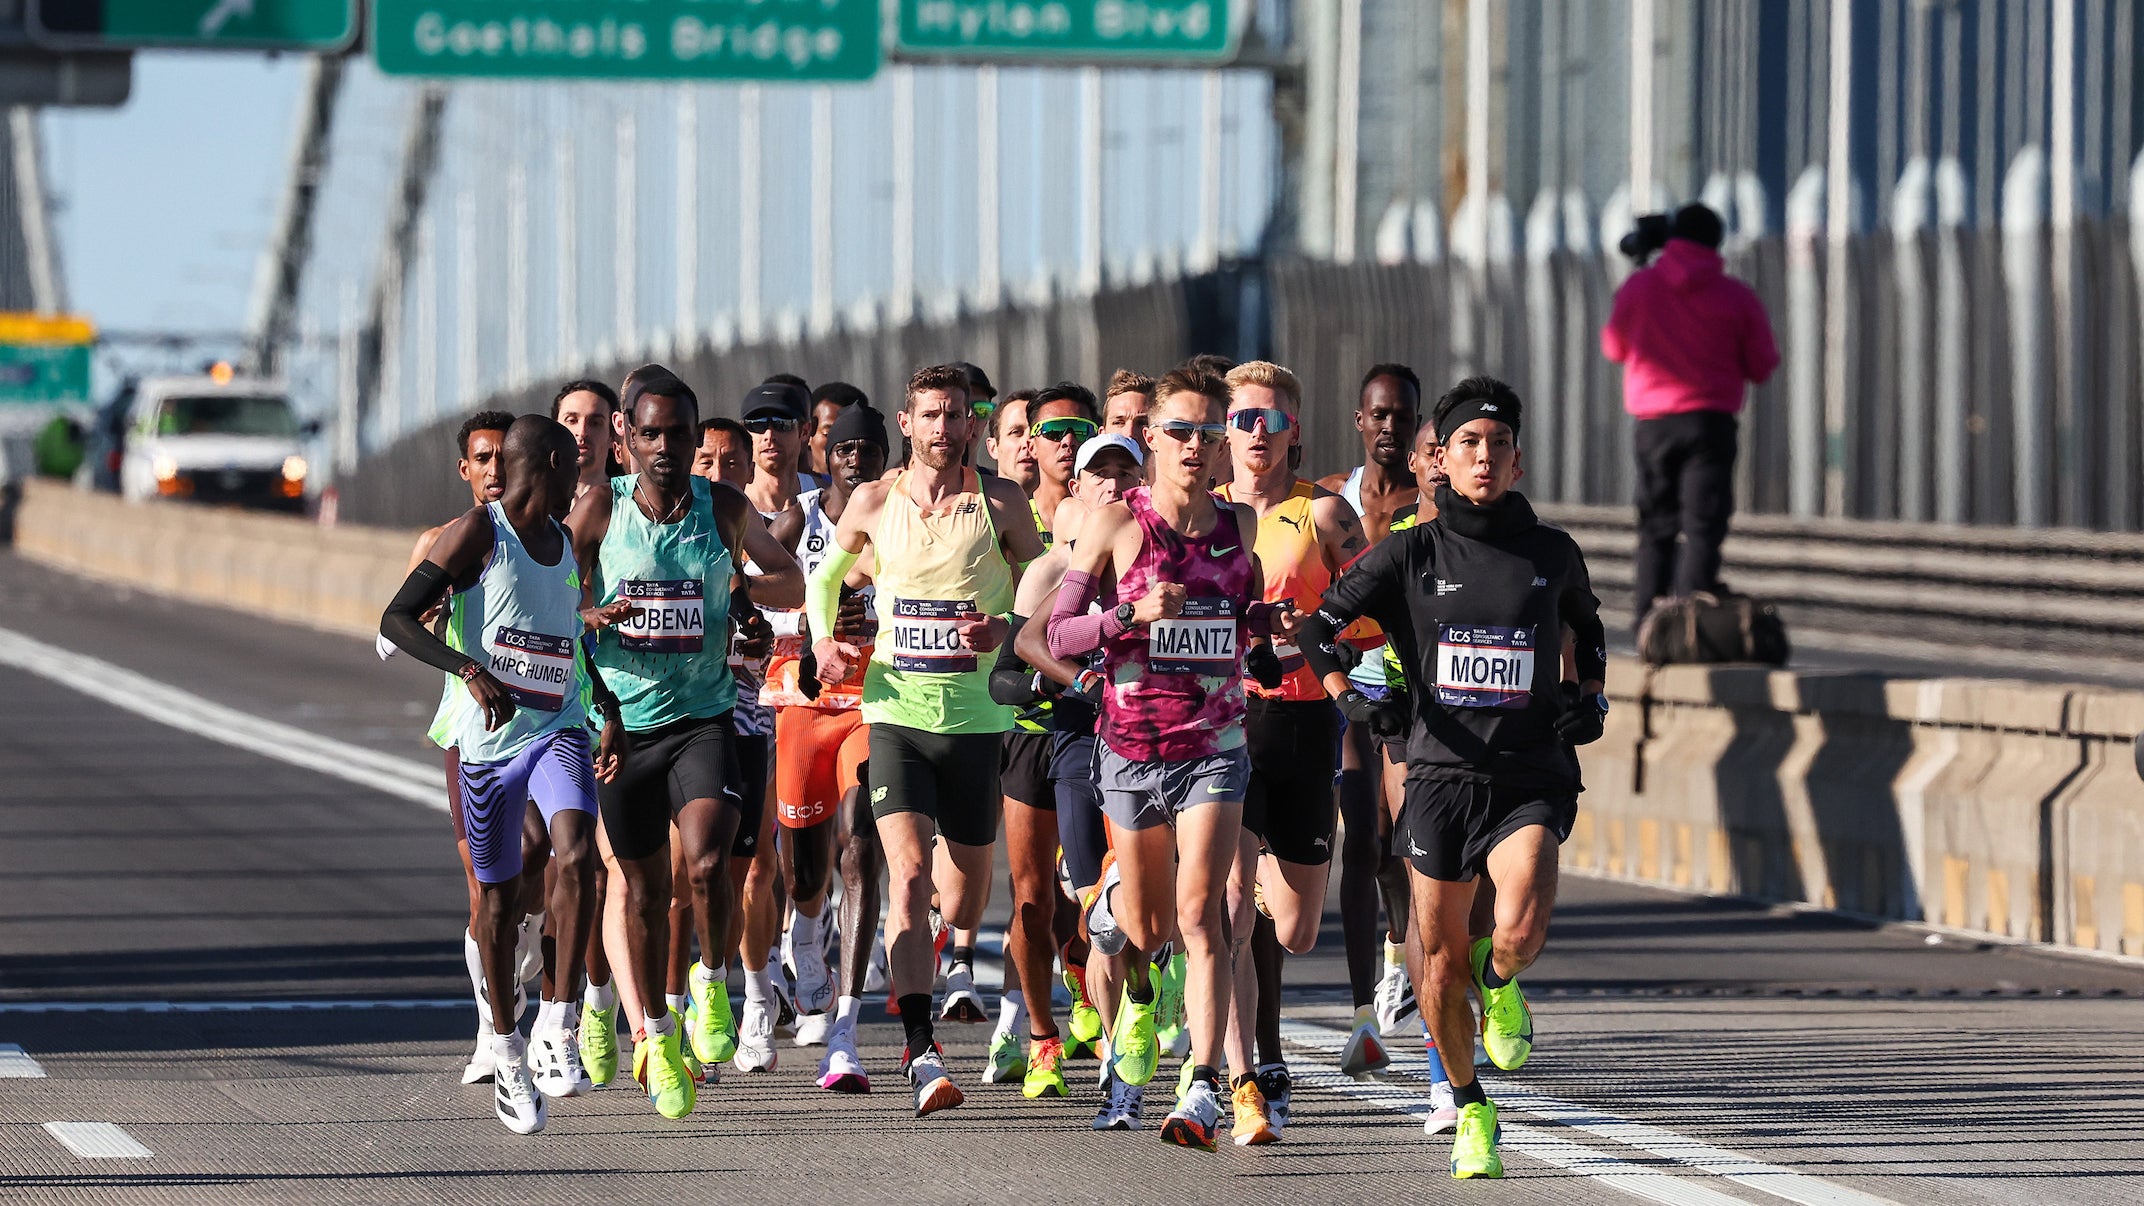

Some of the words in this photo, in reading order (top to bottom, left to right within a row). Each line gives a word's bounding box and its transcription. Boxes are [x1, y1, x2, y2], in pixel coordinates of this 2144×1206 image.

[413, 11, 647, 60] Goethals
[670, 14, 843, 69] Bridge
[624, 582, 645, 596] tcs
[899, 600, 918, 616] tcs
[505, 631, 527, 647] tcs
[895, 626, 970, 650] MELLO
[1156, 627, 1232, 655] MANTZ
[1448, 627, 1471, 643] tcs
[558, 647, 570, 655] TATA
[1451, 655, 1521, 686] MORII
[778, 799, 824, 819] INEOS
